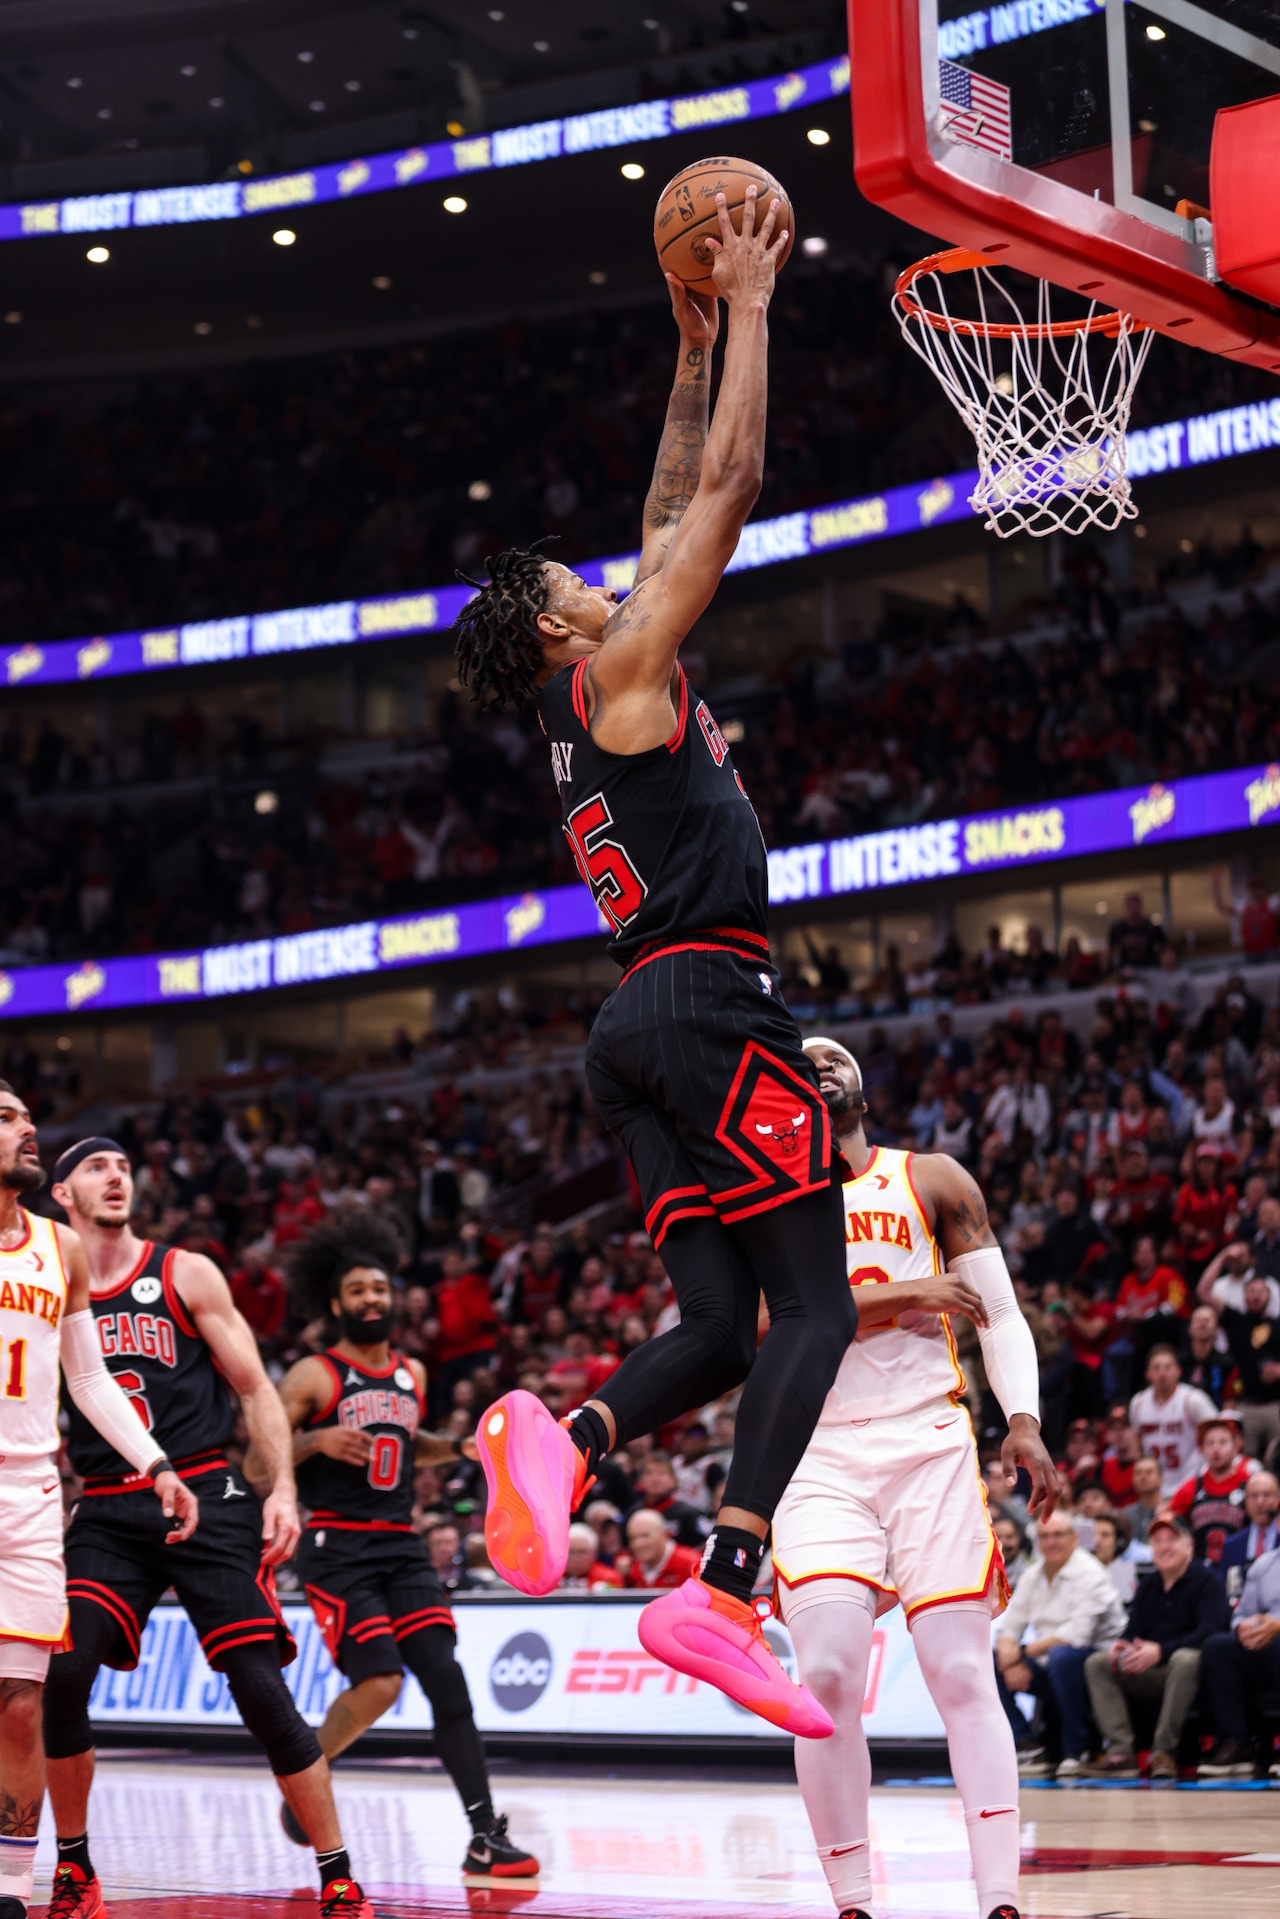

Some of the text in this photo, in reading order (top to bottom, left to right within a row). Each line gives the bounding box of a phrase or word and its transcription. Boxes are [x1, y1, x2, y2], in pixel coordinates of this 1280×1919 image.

[937, 0, 1092, 60] OST INTENSE
[453, 138, 491, 170] THE
[492, 120, 561, 167] MOST
[564, 100, 671, 153] INTENSE
[671, 88, 750, 130] SNACKS
[20, 203, 59, 233] THE
[61, 192, 131, 233] MOST
[133, 181, 241, 226] INTENSE
[562, 791, 649, 940] 5
[767, 844, 826, 902] OST
[829, 820, 960, 892] INTENSE
[964, 807, 1066, 865] SNACKS
[158, 956, 200, 996] THE
[203, 939, 271, 996] MOST
[273, 922, 379, 984] INTENSE
[0, 1336, 28, 1400] 1
[95, 1311, 177, 1369] CAGO
[367, 1431, 405, 1492] 0
[90, 1619, 198, 1711] GIN
[490, 1651, 552, 1687] abc
